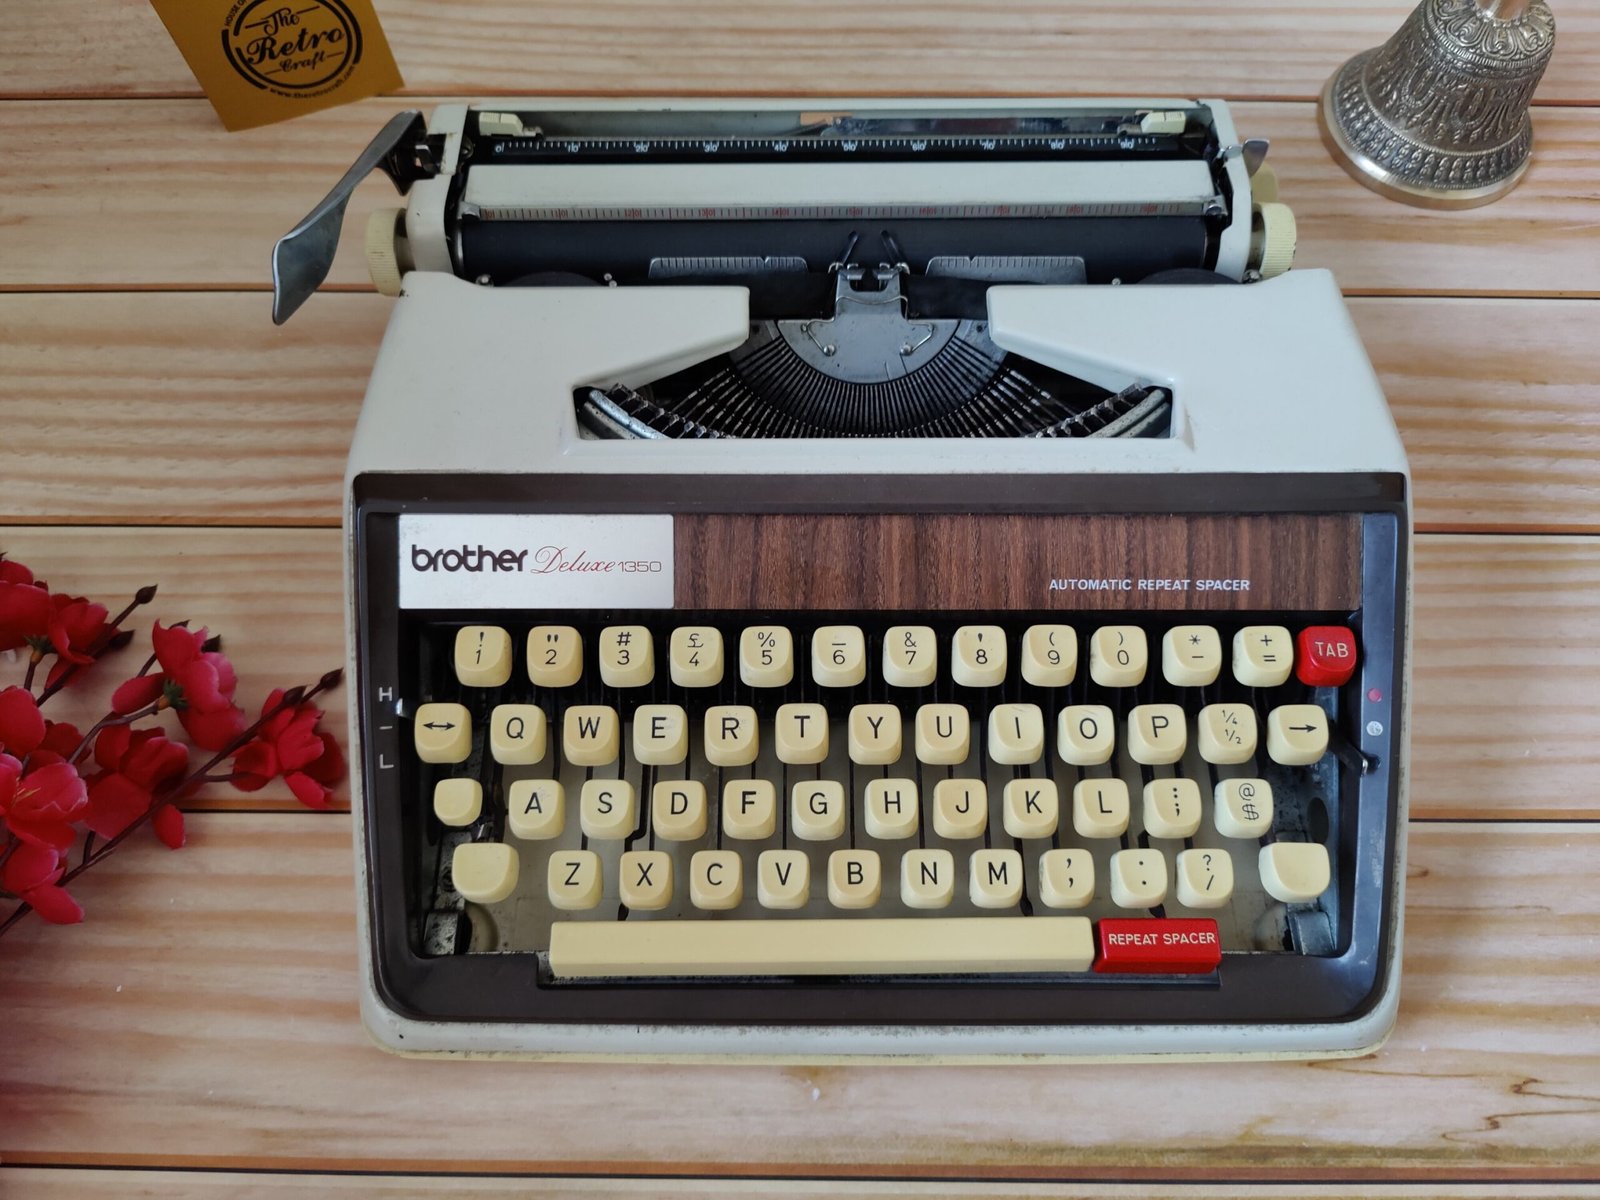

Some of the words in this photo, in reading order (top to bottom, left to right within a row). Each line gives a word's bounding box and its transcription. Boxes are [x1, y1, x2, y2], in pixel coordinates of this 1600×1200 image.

[263, 7, 300, 36] The
[246, 28, 344, 64] Retro
[279, 51, 325, 72] Craft
[411, 544, 528, 572] brother
[530, 545, 616, 574] Deluxe
[618, 560, 662, 572] 1350
[1049, 579, 1131, 590] AUTOMATIC
[1137, 579, 1190, 590] REPEAT
[1195, 579, 1249, 591] SPACER
[616, 631, 632, 647] #
[757, 631, 776, 648] %
[904, 631, 917, 648] &
[1048, 631, 1055, 647] (
[1117, 631, 1124, 646] )
[1315, 641, 1349, 658] TAB
[475, 649, 482, 665] 1
[544, 648, 557, 665] 2
[617, 649, 630, 666] 3
[688, 651, 700, 667] 4
[761, 649, 773, 666] 5
[832, 649, 846, 665] 6
[905, 650, 917, 665] 7
[975, 648, 988, 665] 8
[1047, 649, 1061, 665] 9
[1116, 649, 1130, 666] 0
[378, 687, 393, 701] H
[506, 716, 525, 740] Q
[578, 716, 601, 739] W
[651, 716, 667, 739] E
[721, 717, 740, 740] R
[793, 715, 811, 739] T
[866, 716, 884, 740] Y
[936, 715, 953, 738] U
[1014, 716, 1021, 740] I
[1079, 717, 1098, 740] O
[1151, 715, 1169, 739] P
[379, 754, 394, 769] L
[524, 791, 542, 815] A
[597, 791, 613, 815] S
[670, 791, 689, 815] D
[741, 790, 757, 815] F
[883, 790, 901, 814] H
[955, 790, 970, 814] J
[1025, 790, 1043, 814] K
[1097, 790, 1113, 814] L
[1239, 782, 1255, 801] @
[809, 792, 828, 815] G
[1242, 803, 1260, 821] $
[564, 862, 581, 886] Z
[636, 862, 654, 887] X
[706, 862, 723, 886] C
[775, 862, 792, 886] V
[847, 861, 864, 885] B
[920, 861, 938, 886] N
[987, 861, 1008, 885] M
[1202, 854, 1212, 872] ?
[1206, 874, 1215, 891] /
[1108, 933, 1158, 945] REPEAT
[1163, 932, 1215, 944] SPACER
